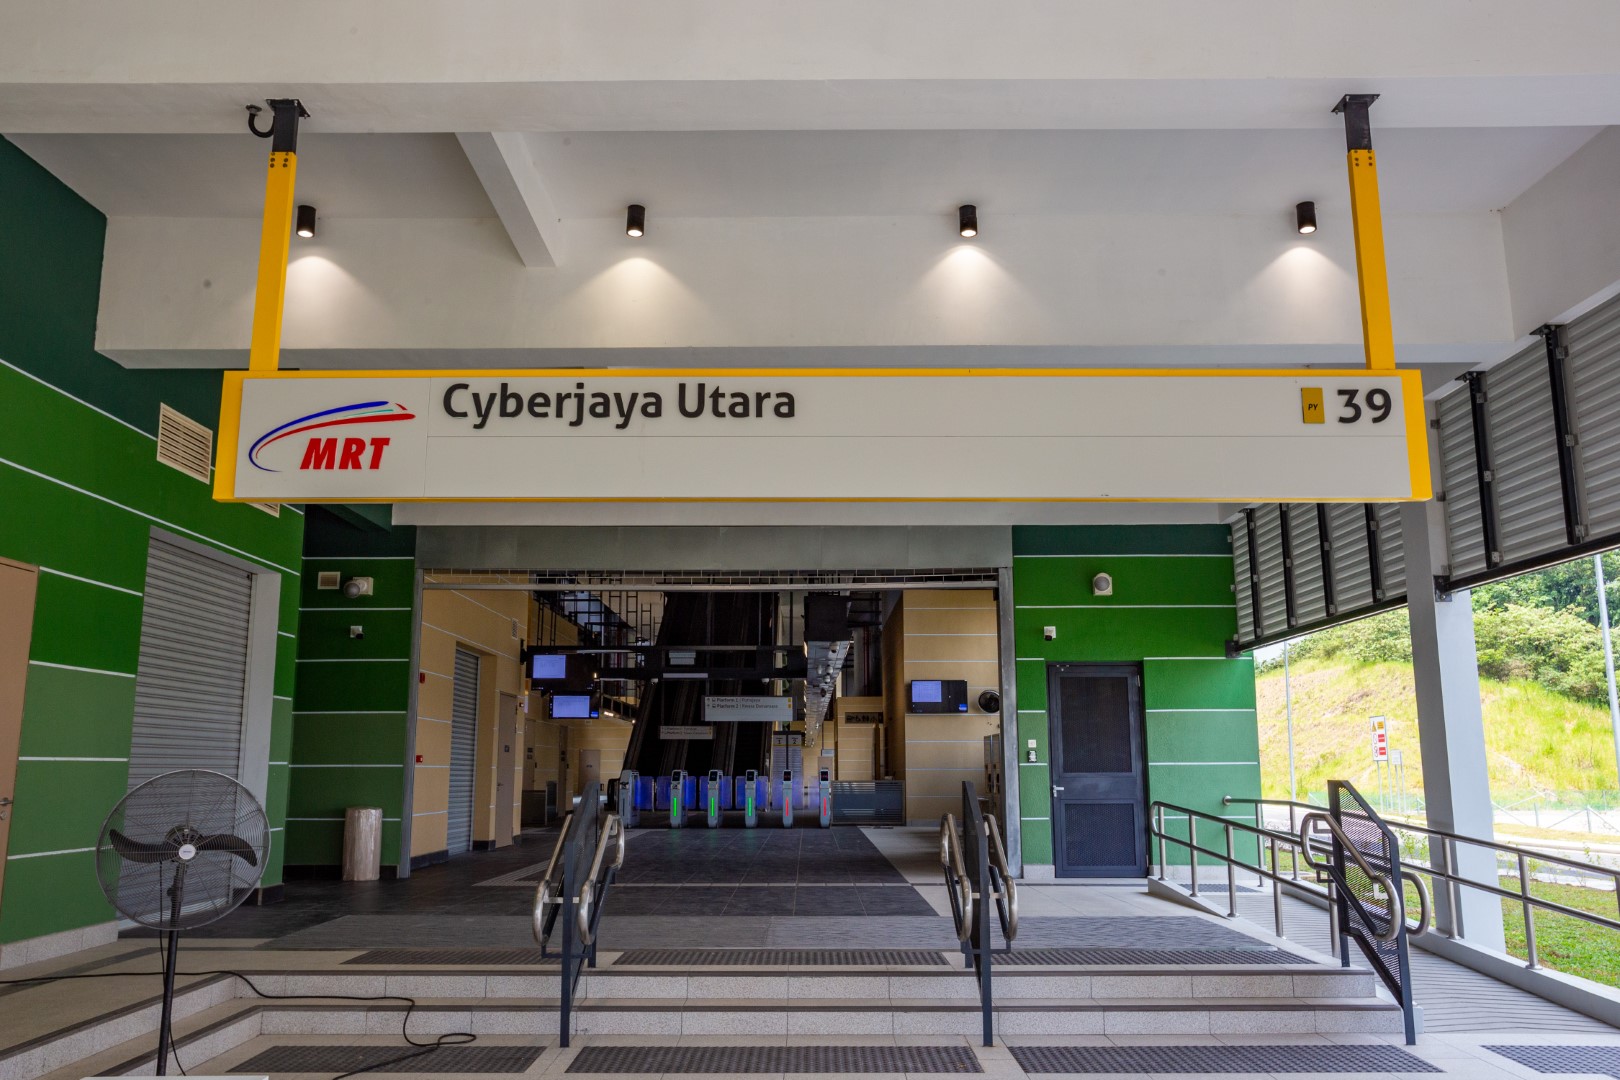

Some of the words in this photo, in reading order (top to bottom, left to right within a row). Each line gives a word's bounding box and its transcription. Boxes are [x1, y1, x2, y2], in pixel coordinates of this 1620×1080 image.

[443, 383, 663, 429] Cyberjaya
[677, 382, 796, 418] Utara
[1308, 403, 1318, 411] PY
[1337, 388, 1392, 424] 39
[300, 437, 390, 470] MRT
